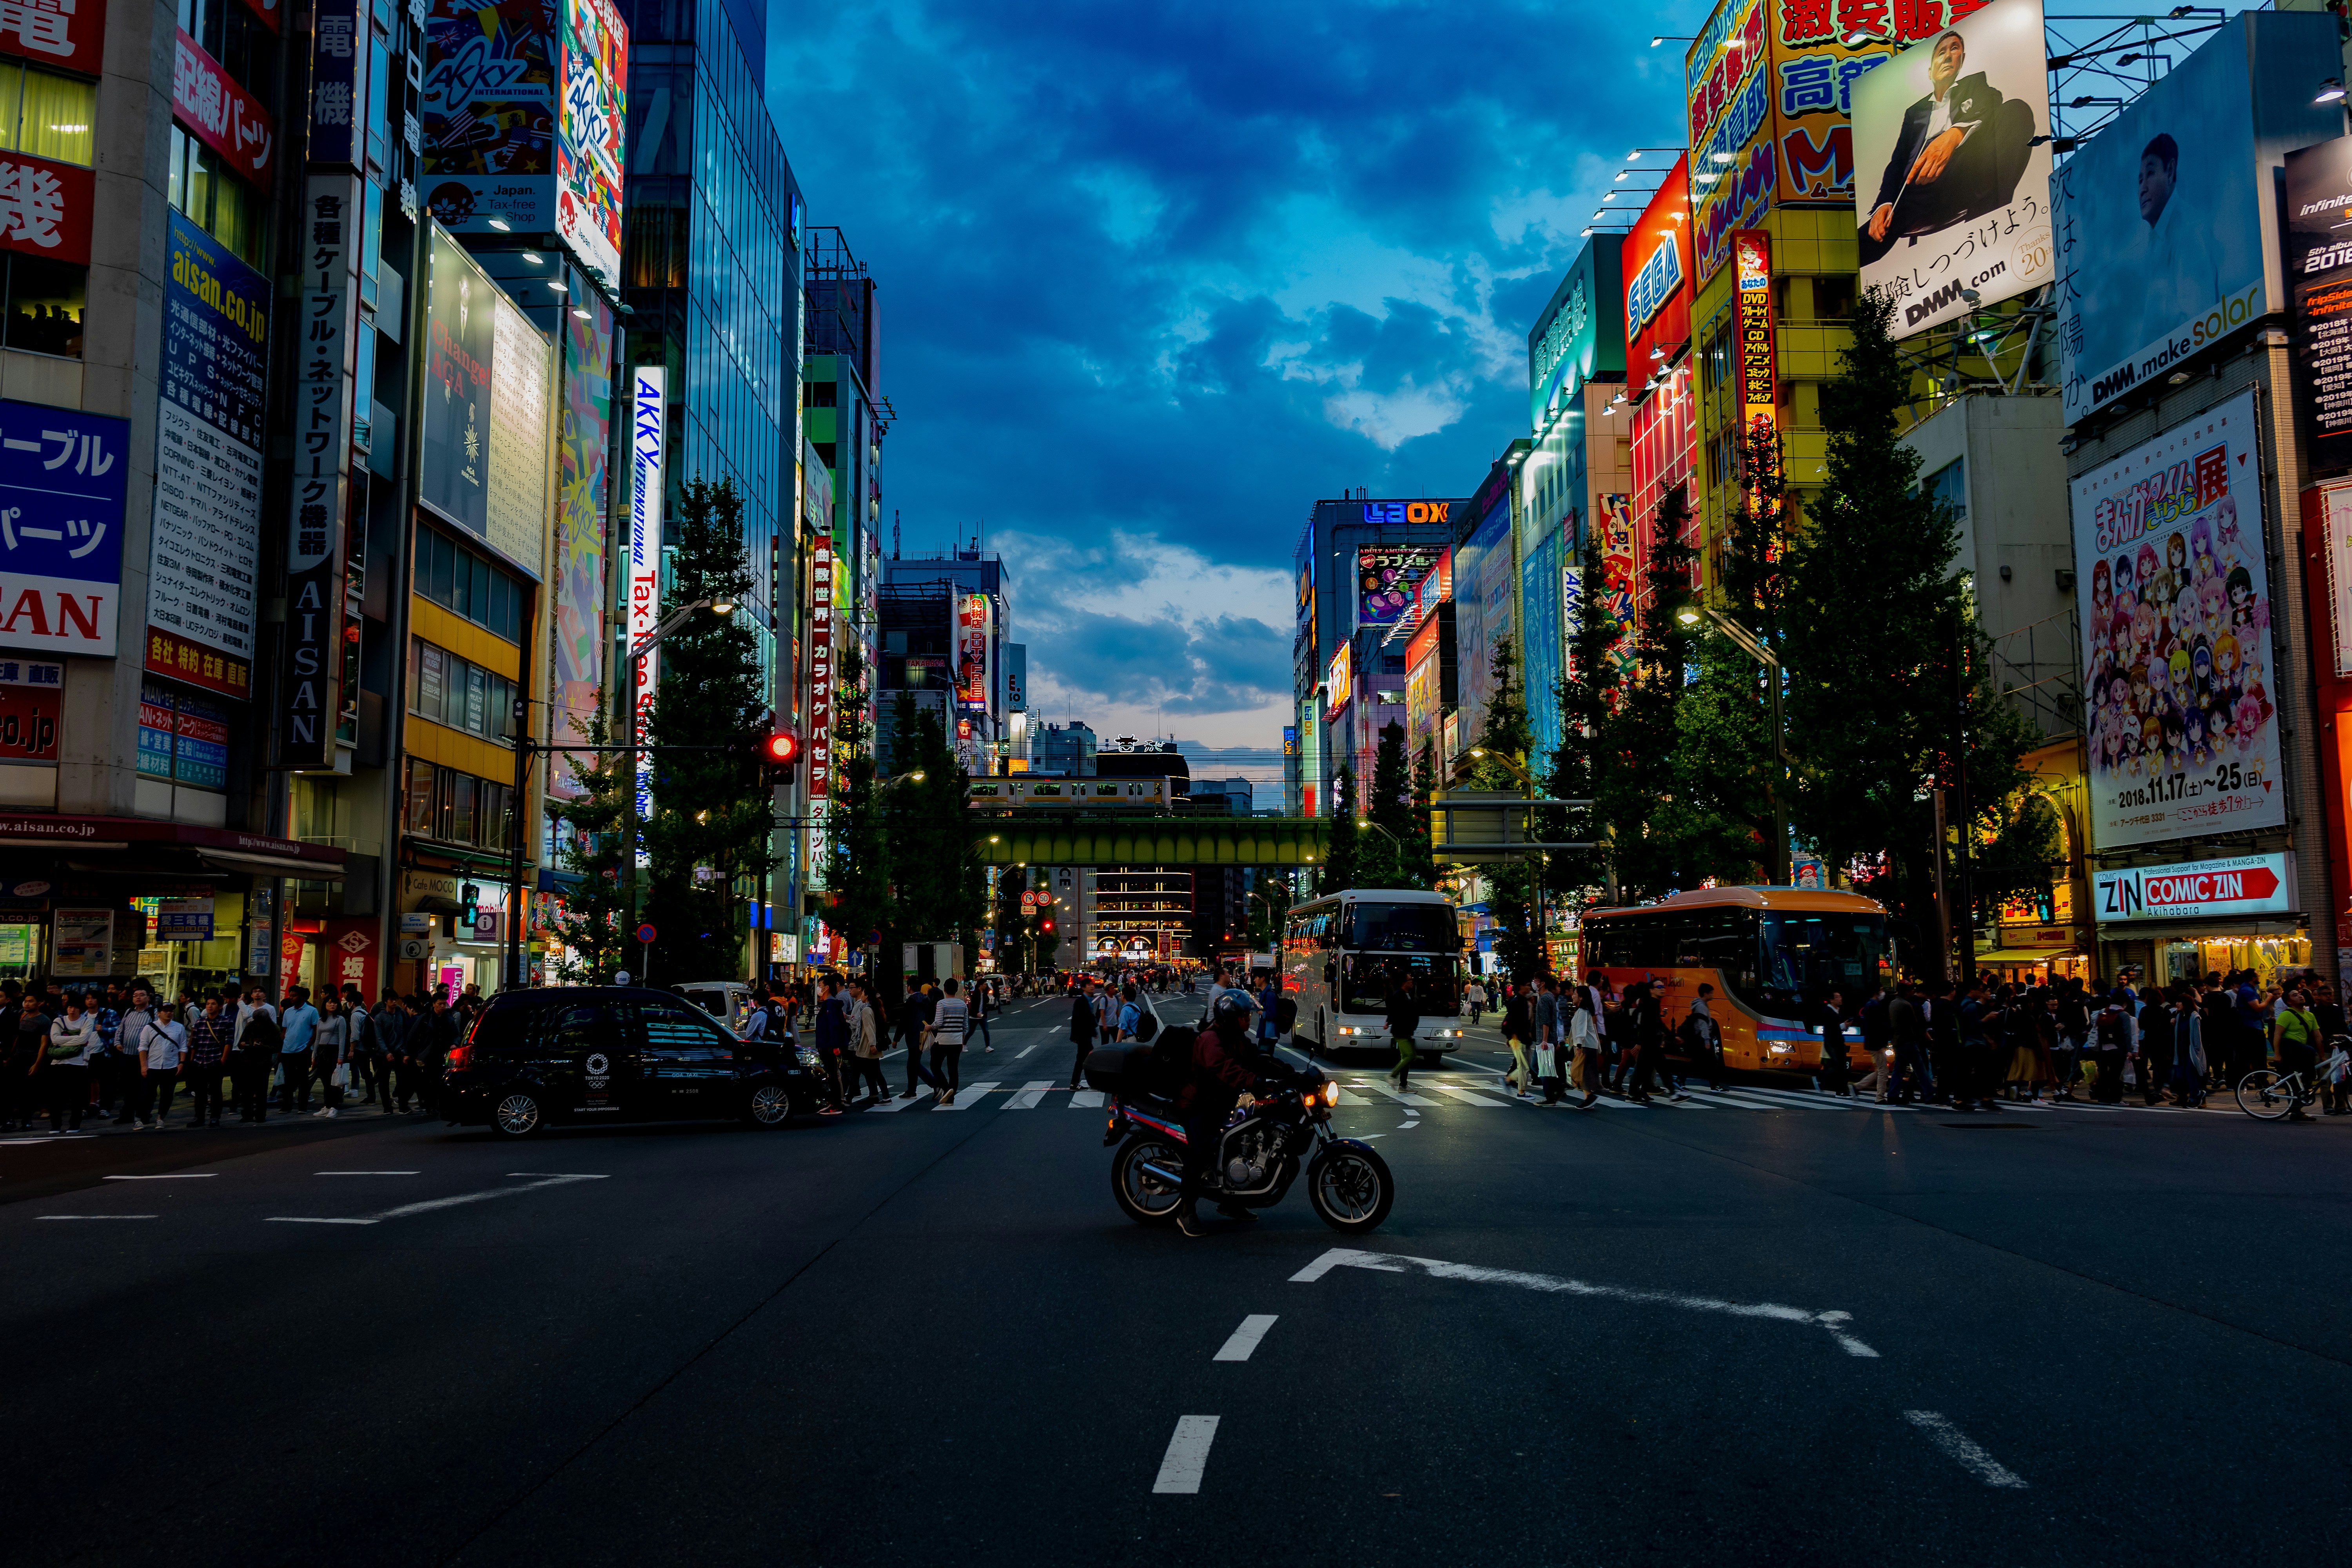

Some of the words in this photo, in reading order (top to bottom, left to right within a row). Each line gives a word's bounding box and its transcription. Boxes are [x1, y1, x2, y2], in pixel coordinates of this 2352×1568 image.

[589, 137, 616, 180] INTERNATIONAL
[493, 185, 535, 196] Japan.
[489, 199, 535, 211] Tax-free
[506, 211, 535, 223] Shop
[2018, 231, 2051, 254] Thanks
[2021, 245, 2054, 276] 20th
[1627, 230, 1684, 343] SEGA
[1741, 278, 1766, 289] あなたの
[1906, 259, 2007, 328] DMMcom
[2051, 167, 2088, 416] 次は太陽か。
[173, 250, 265, 343] aisan.co.jp
[1743, 294, 1766, 304] DVD
[1742, 305, 1768, 316] ブルーレイ
[1742, 318, 1769, 329] ゲーム
[1749, 331, 1764, 341] CD
[2092, 336, 2190, 406] DMM.make
[2192, 288, 2257, 347] solar
[433, 319, 490, 390] Change!
[1744, 343, 1769, 354] アイドル
[1745, 355, 1770, 365] アニメ
[1746, 367, 1770, 377] コミック
[1748, 380, 1771, 390] ホビー
[1747, 392, 1771, 403] フィギュア
[637, 377, 660, 469] AKKY
[0, 428, 114, 477] ーブル
[2194, 440, 2230, 515] 展
[633, 446, 645, 567] INTERNATIONAL
[0, 587, 103, 641] AN
[970, 598, 984, 630] 免税店
[970, 632, 984, 662] DUTY
[152, 635, 173, 664] 各社
[178, 644, 199, 673] 特約
[203, 653, 223, 681] 在庫
[228, 662, 247, 687] 直販
[290, 581, 322, 743] AISAN
[0, 662, 19, 682] 庫
[29, 664, 59, 684] 直販
[970, 664, 983, 697] FREE
[239, 835, 300, 855] http://www.aisan.co.jp
[2144, 866, 2171, 875] Professional
[2172, 864, 2190, 874] Support
[2200, 861, 2227, 871] Magazine
[2232, 856, 2266, 866] MANGA-ZIN
[413, 878, 428, 890] Cafe
[429, 880, 454, 893] MOCO
[2098, 873, 2117, 882] COMIC
[2146, 875, 2209, 904] COMIC
[2214, 873, 2243, 898] ZIN
[0, 914, 38, 922] .co.jp
[2147, 905, 2199, 917] Akihabara
[1650, 972, 1666, 987] Dream
[1668, 974, 1685, 987] Japan
